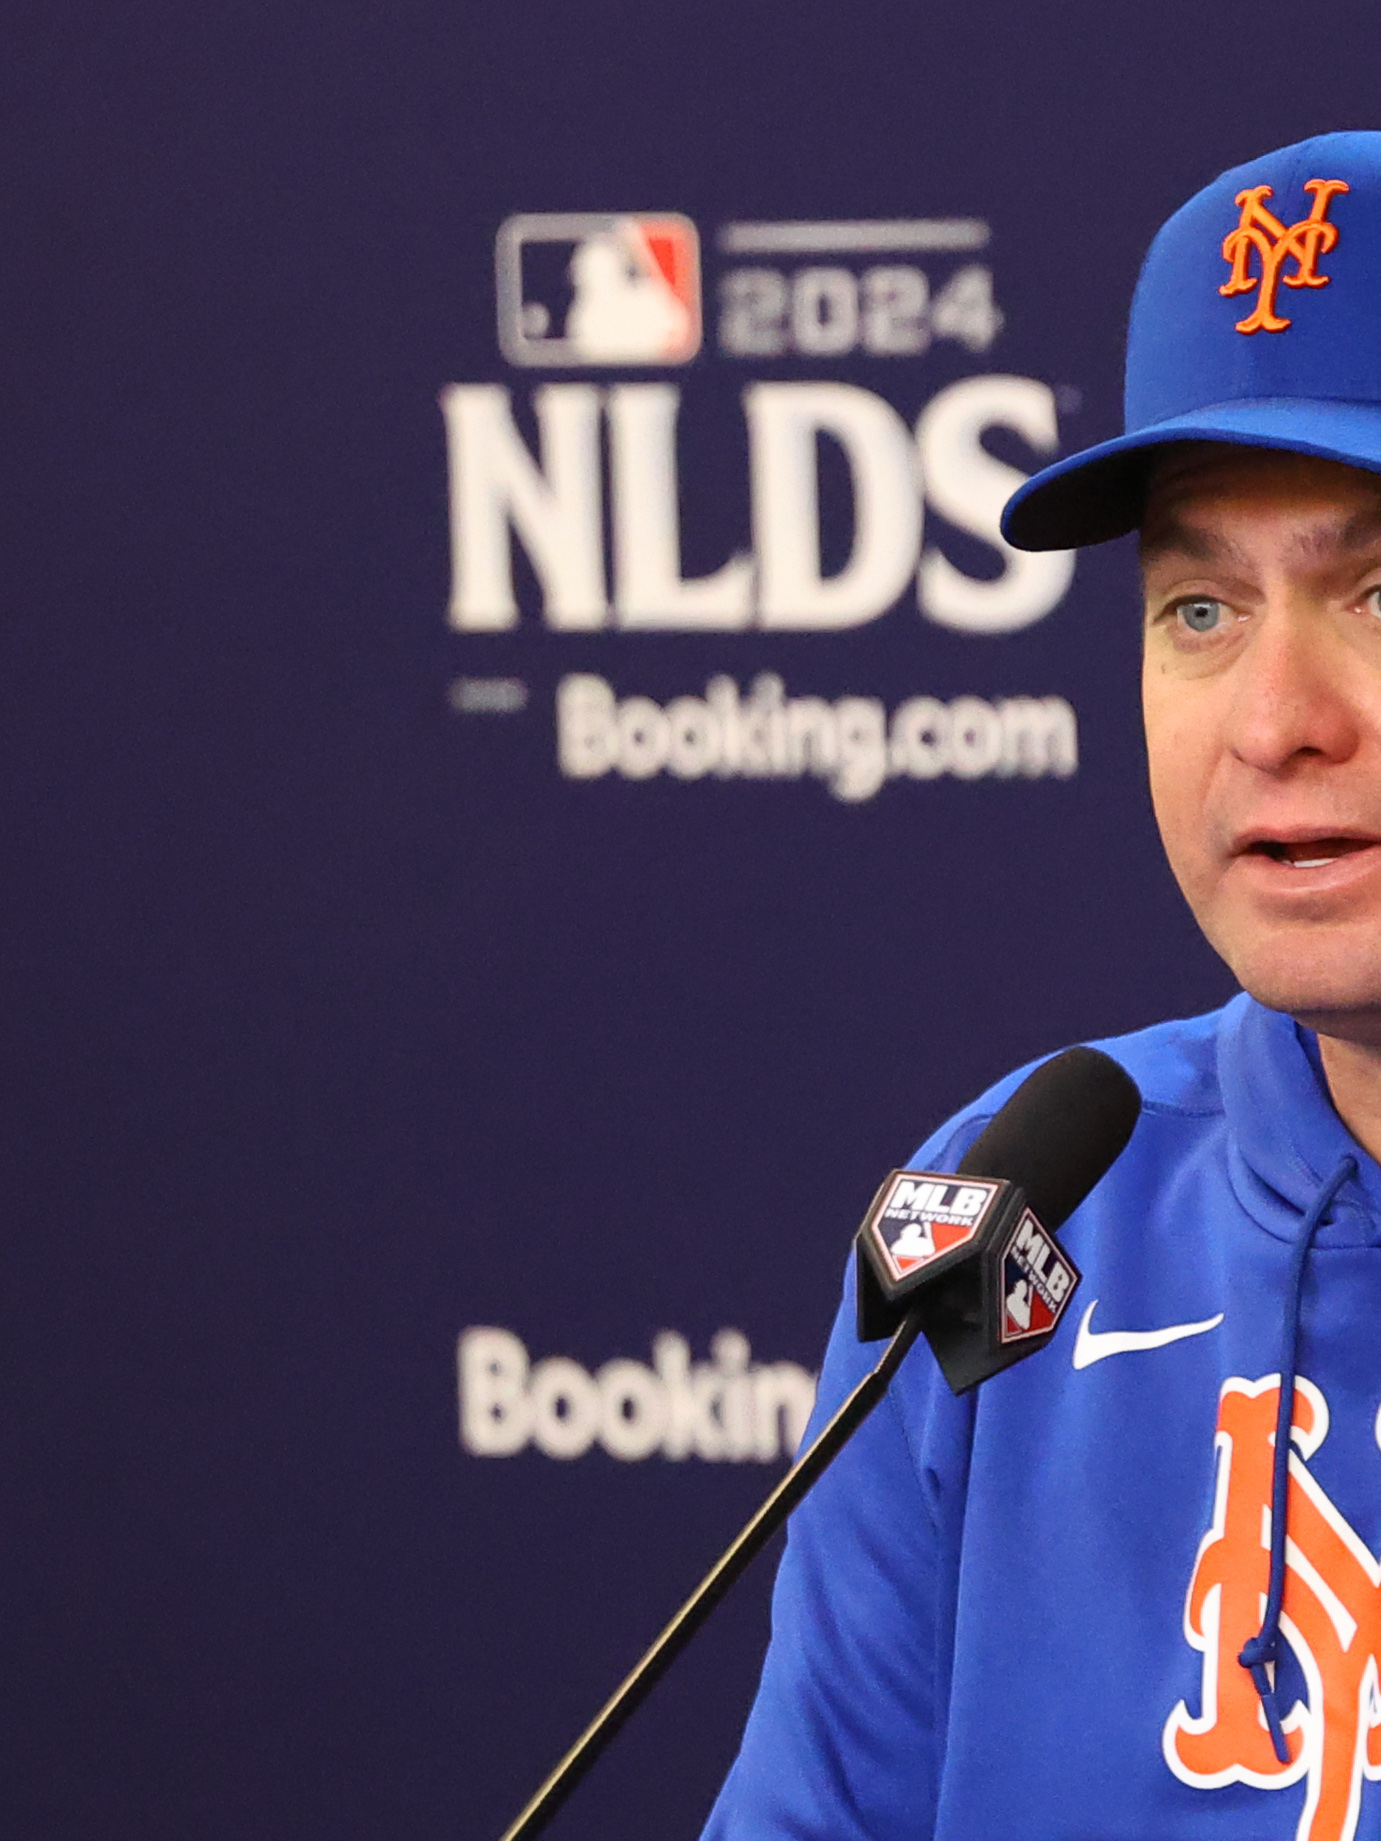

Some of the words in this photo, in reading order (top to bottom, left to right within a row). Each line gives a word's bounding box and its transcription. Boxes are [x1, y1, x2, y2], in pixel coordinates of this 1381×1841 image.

[719, 265, 1003, 357] 2024
[442, 375, 1076, 633] NLDS
[556, 672, 1077, 801] Booking.com
[884, 1208, 975, 1226] NETWORK
[889, 1180, 988, 1217] MLB
[1009, 1247, 1058, 1314] NETWORK
[1015, 1219, 1070, 1299] MLB
[457, 1325, 818, 1463] Bookin
